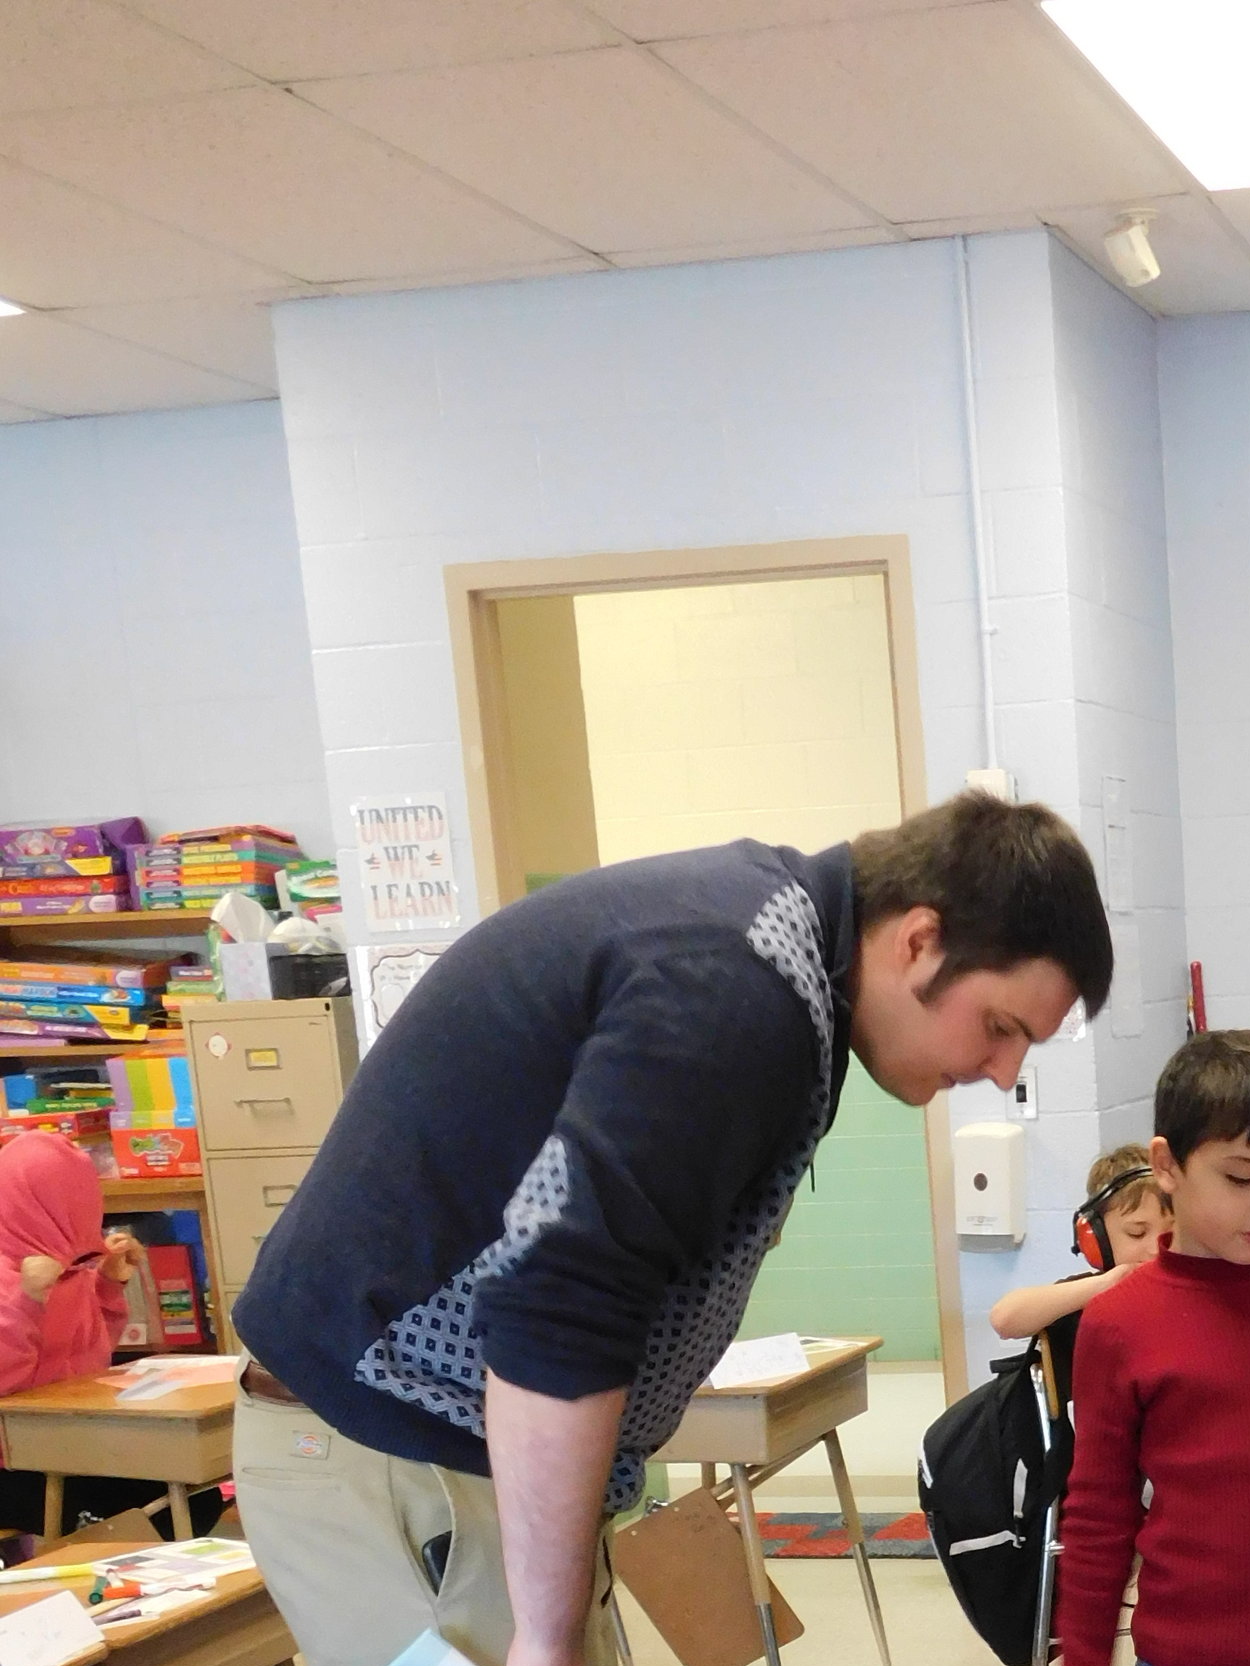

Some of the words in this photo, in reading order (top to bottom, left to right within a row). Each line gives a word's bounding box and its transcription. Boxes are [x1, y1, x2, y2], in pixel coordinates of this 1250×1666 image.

[357, 804, 444, 845] UNITED
[382, 844, 423, 881] WE
[369, 880, 454, 920] LEARN
